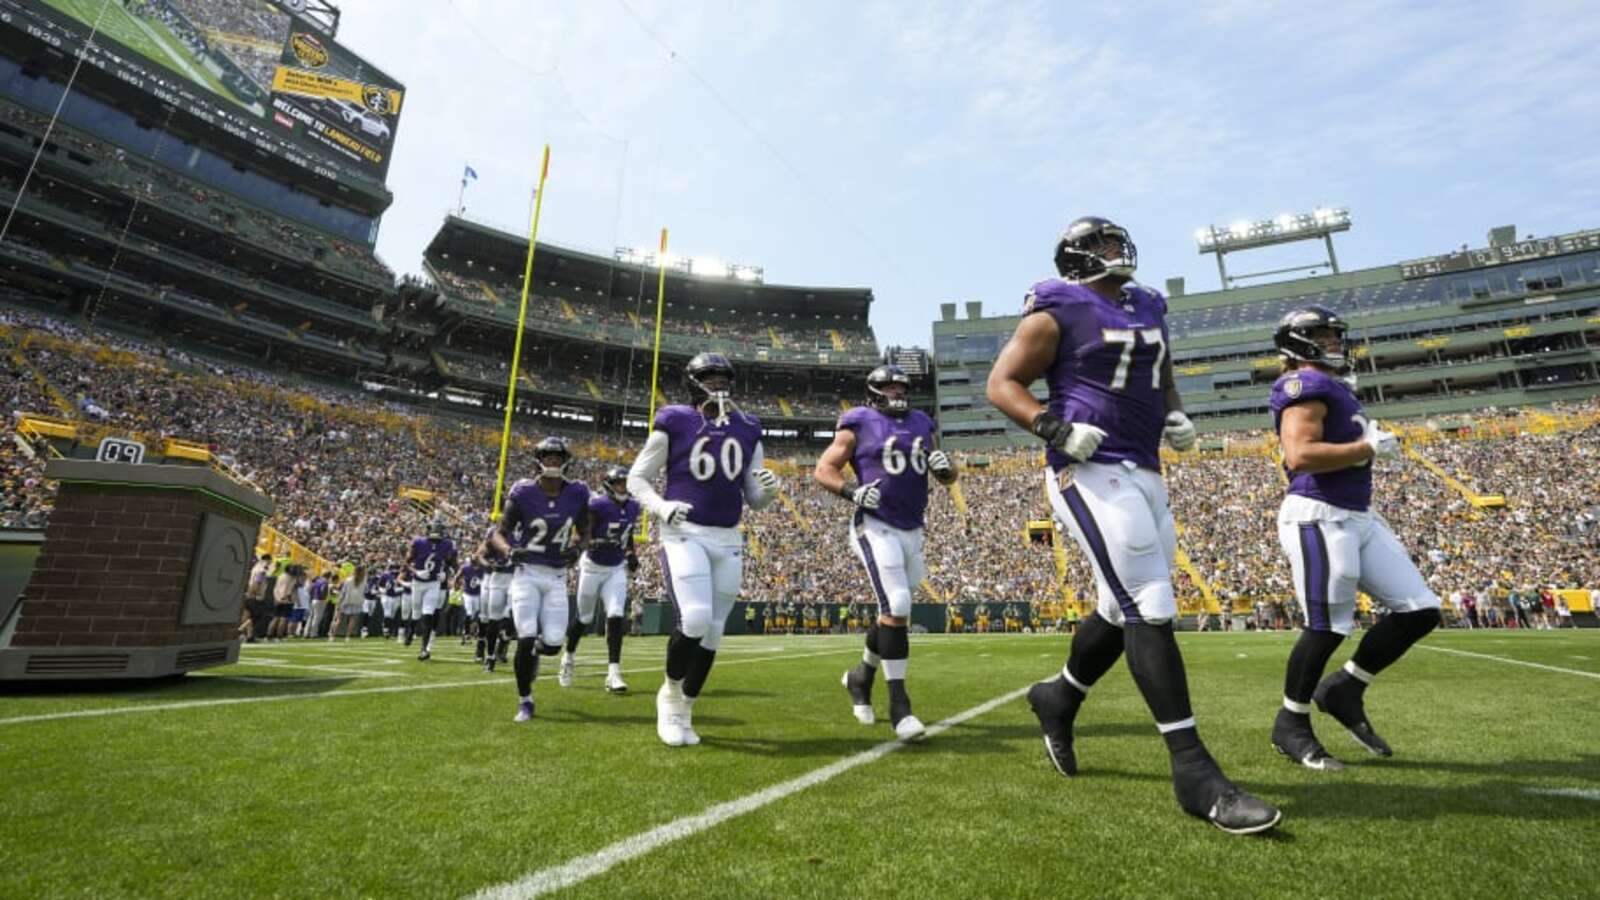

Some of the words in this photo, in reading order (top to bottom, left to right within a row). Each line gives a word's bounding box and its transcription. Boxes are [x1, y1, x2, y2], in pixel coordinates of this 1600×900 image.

[273, 98, 314, 125] WELCOME
[313, 120, 325, 132] TO
[1101, 328, 1166, 389] 77
[105, 443, 137, 464] 09
[689, 436, 743, 480] 60
[882, 435, 928, 475] 66
[527, 517, 573, 552] 24
